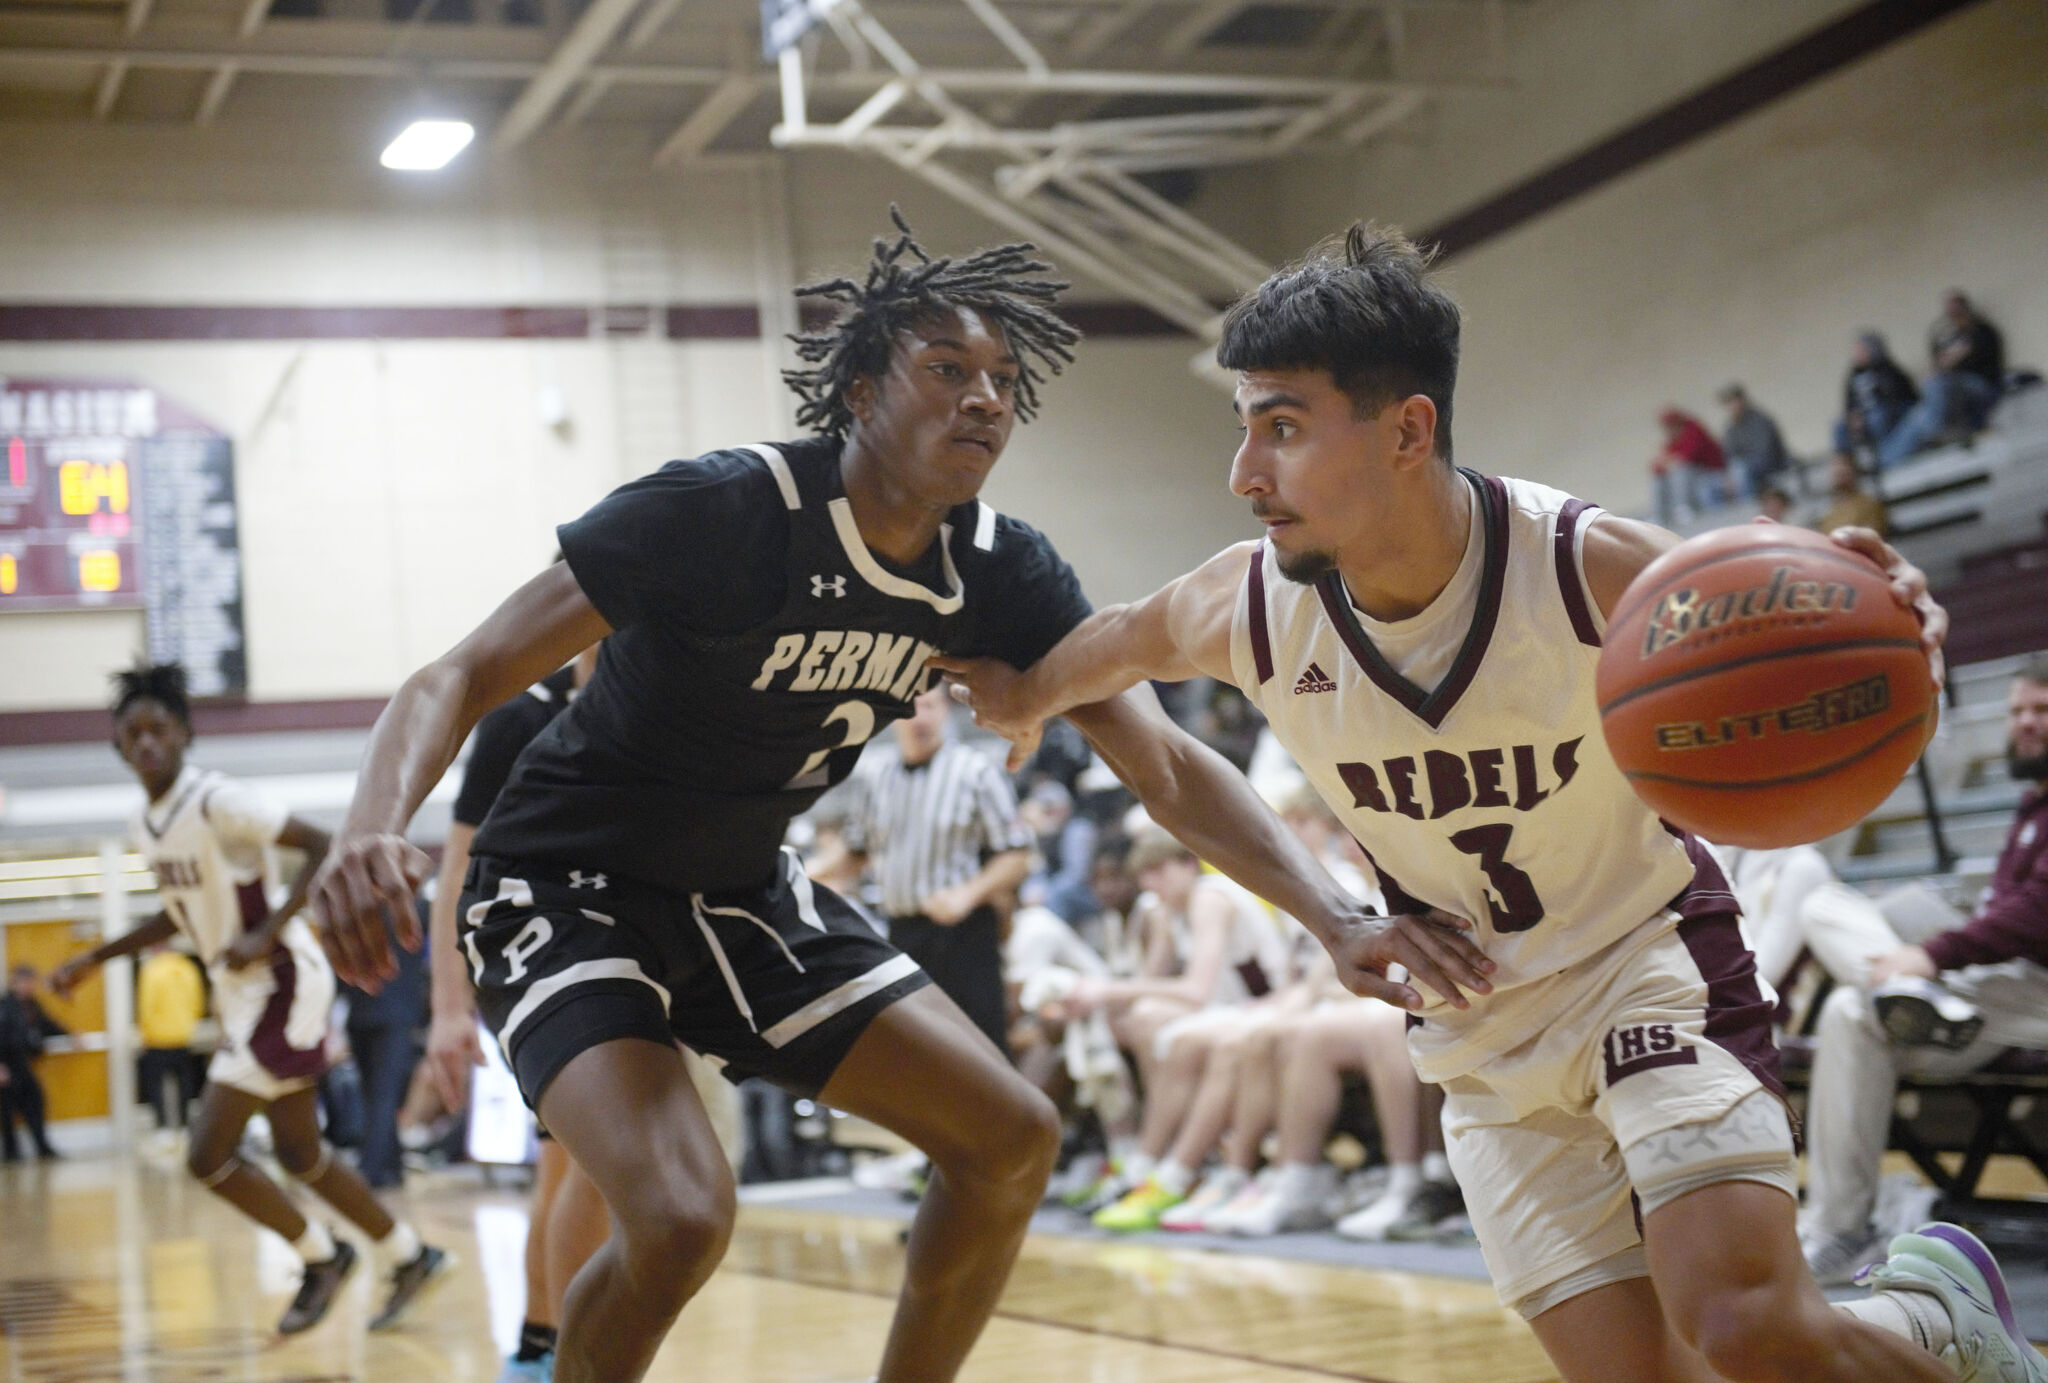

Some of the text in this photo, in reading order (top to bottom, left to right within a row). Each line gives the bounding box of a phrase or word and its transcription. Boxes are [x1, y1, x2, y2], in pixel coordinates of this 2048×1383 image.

[1640, 566, 1857, 660] Baden
[751, 630, 945, 703] PERMIA
[1294, 681, 1337, 695] adidas
[783, 699, 875, 790] 2
[1336, 734, 1586, 820] REBELS
[1448, 822, 1544, 933] 3
[501, 916, 553, 984] P
